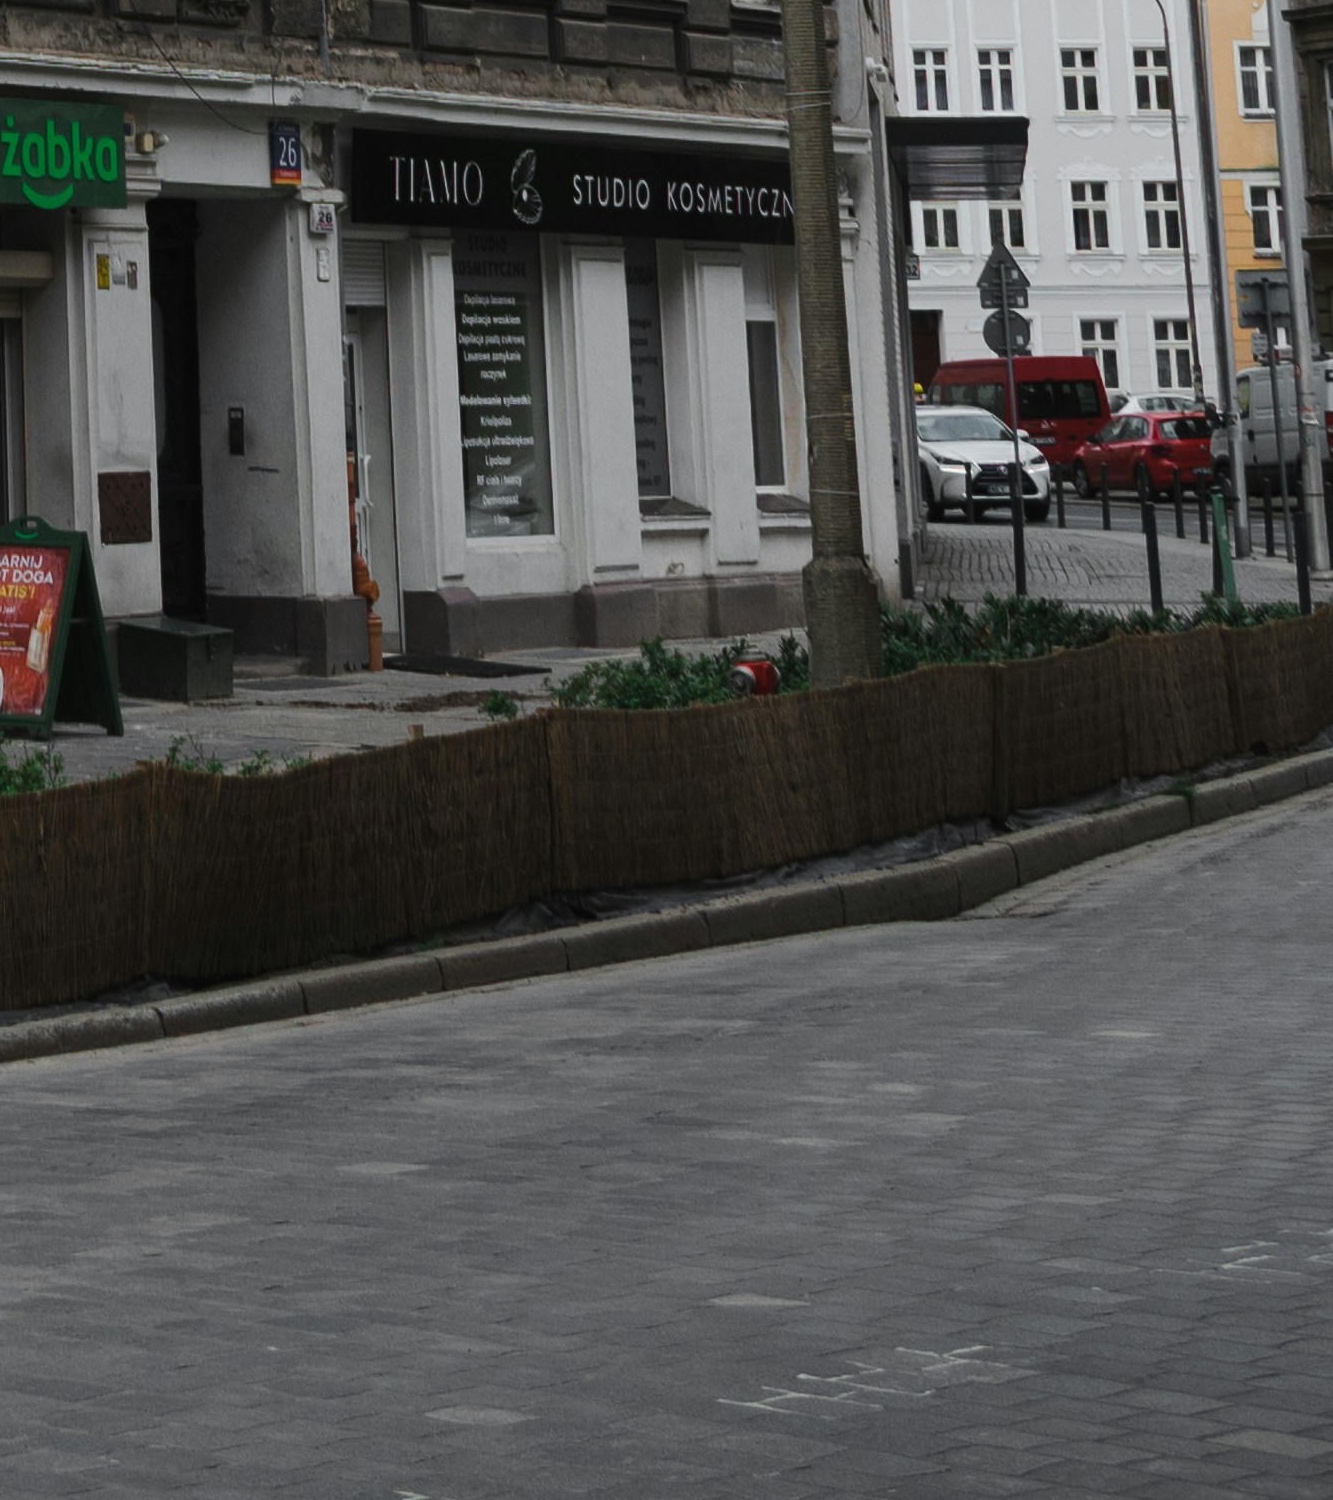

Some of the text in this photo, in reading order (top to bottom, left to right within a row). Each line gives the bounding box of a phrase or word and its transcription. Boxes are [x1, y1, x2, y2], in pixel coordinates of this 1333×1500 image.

[0, 115, 118, 182] żabka
[279, 137, 297, 167] 26
[389, 156, 795, 217] TIAMO STUDIO KOSMETYCZN
[468, 234, 508, 252] STUDIO
[12, 569, 54, 584] DOGA
